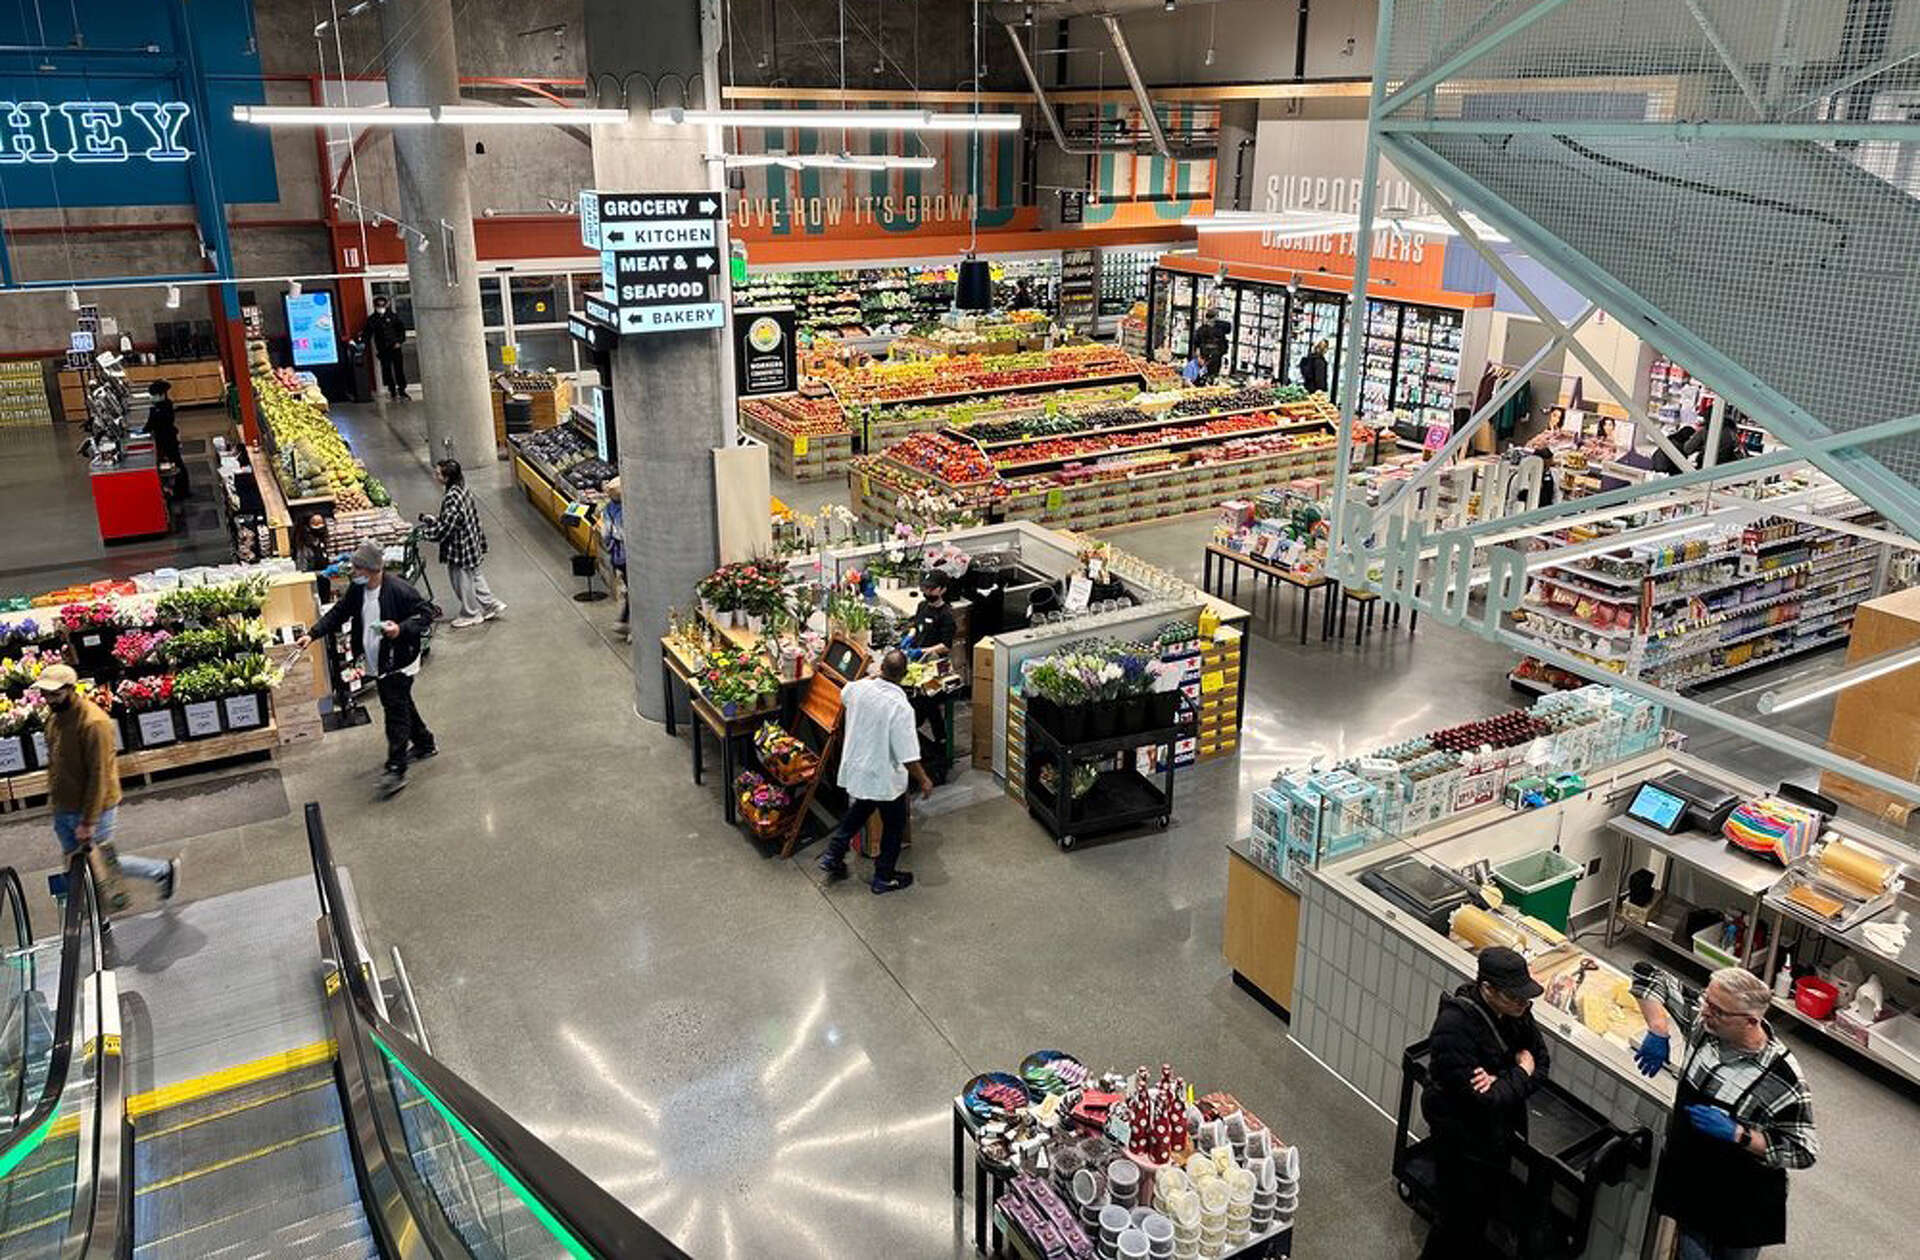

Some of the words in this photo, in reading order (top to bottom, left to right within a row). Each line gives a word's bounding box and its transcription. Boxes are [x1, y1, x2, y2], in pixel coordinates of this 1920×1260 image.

[0, 101, 190, 162] HEY
[604, 199, 689, 216] GROCERY
[728, 197, 781, 228] OVE
[793, 196, 842, 226] HOW
[855, 194, 895, 224] IT'S
[635, 228, 712, 243] KITCHEN
[1339, 231, 1424, 263] FAMERS
[619, 256, 670, 272] MEAT
[673, 254, 688, 270] &
[622, 281, 704, 300] SEAFOOD
[652, 309, 716, 324] BAKERY
